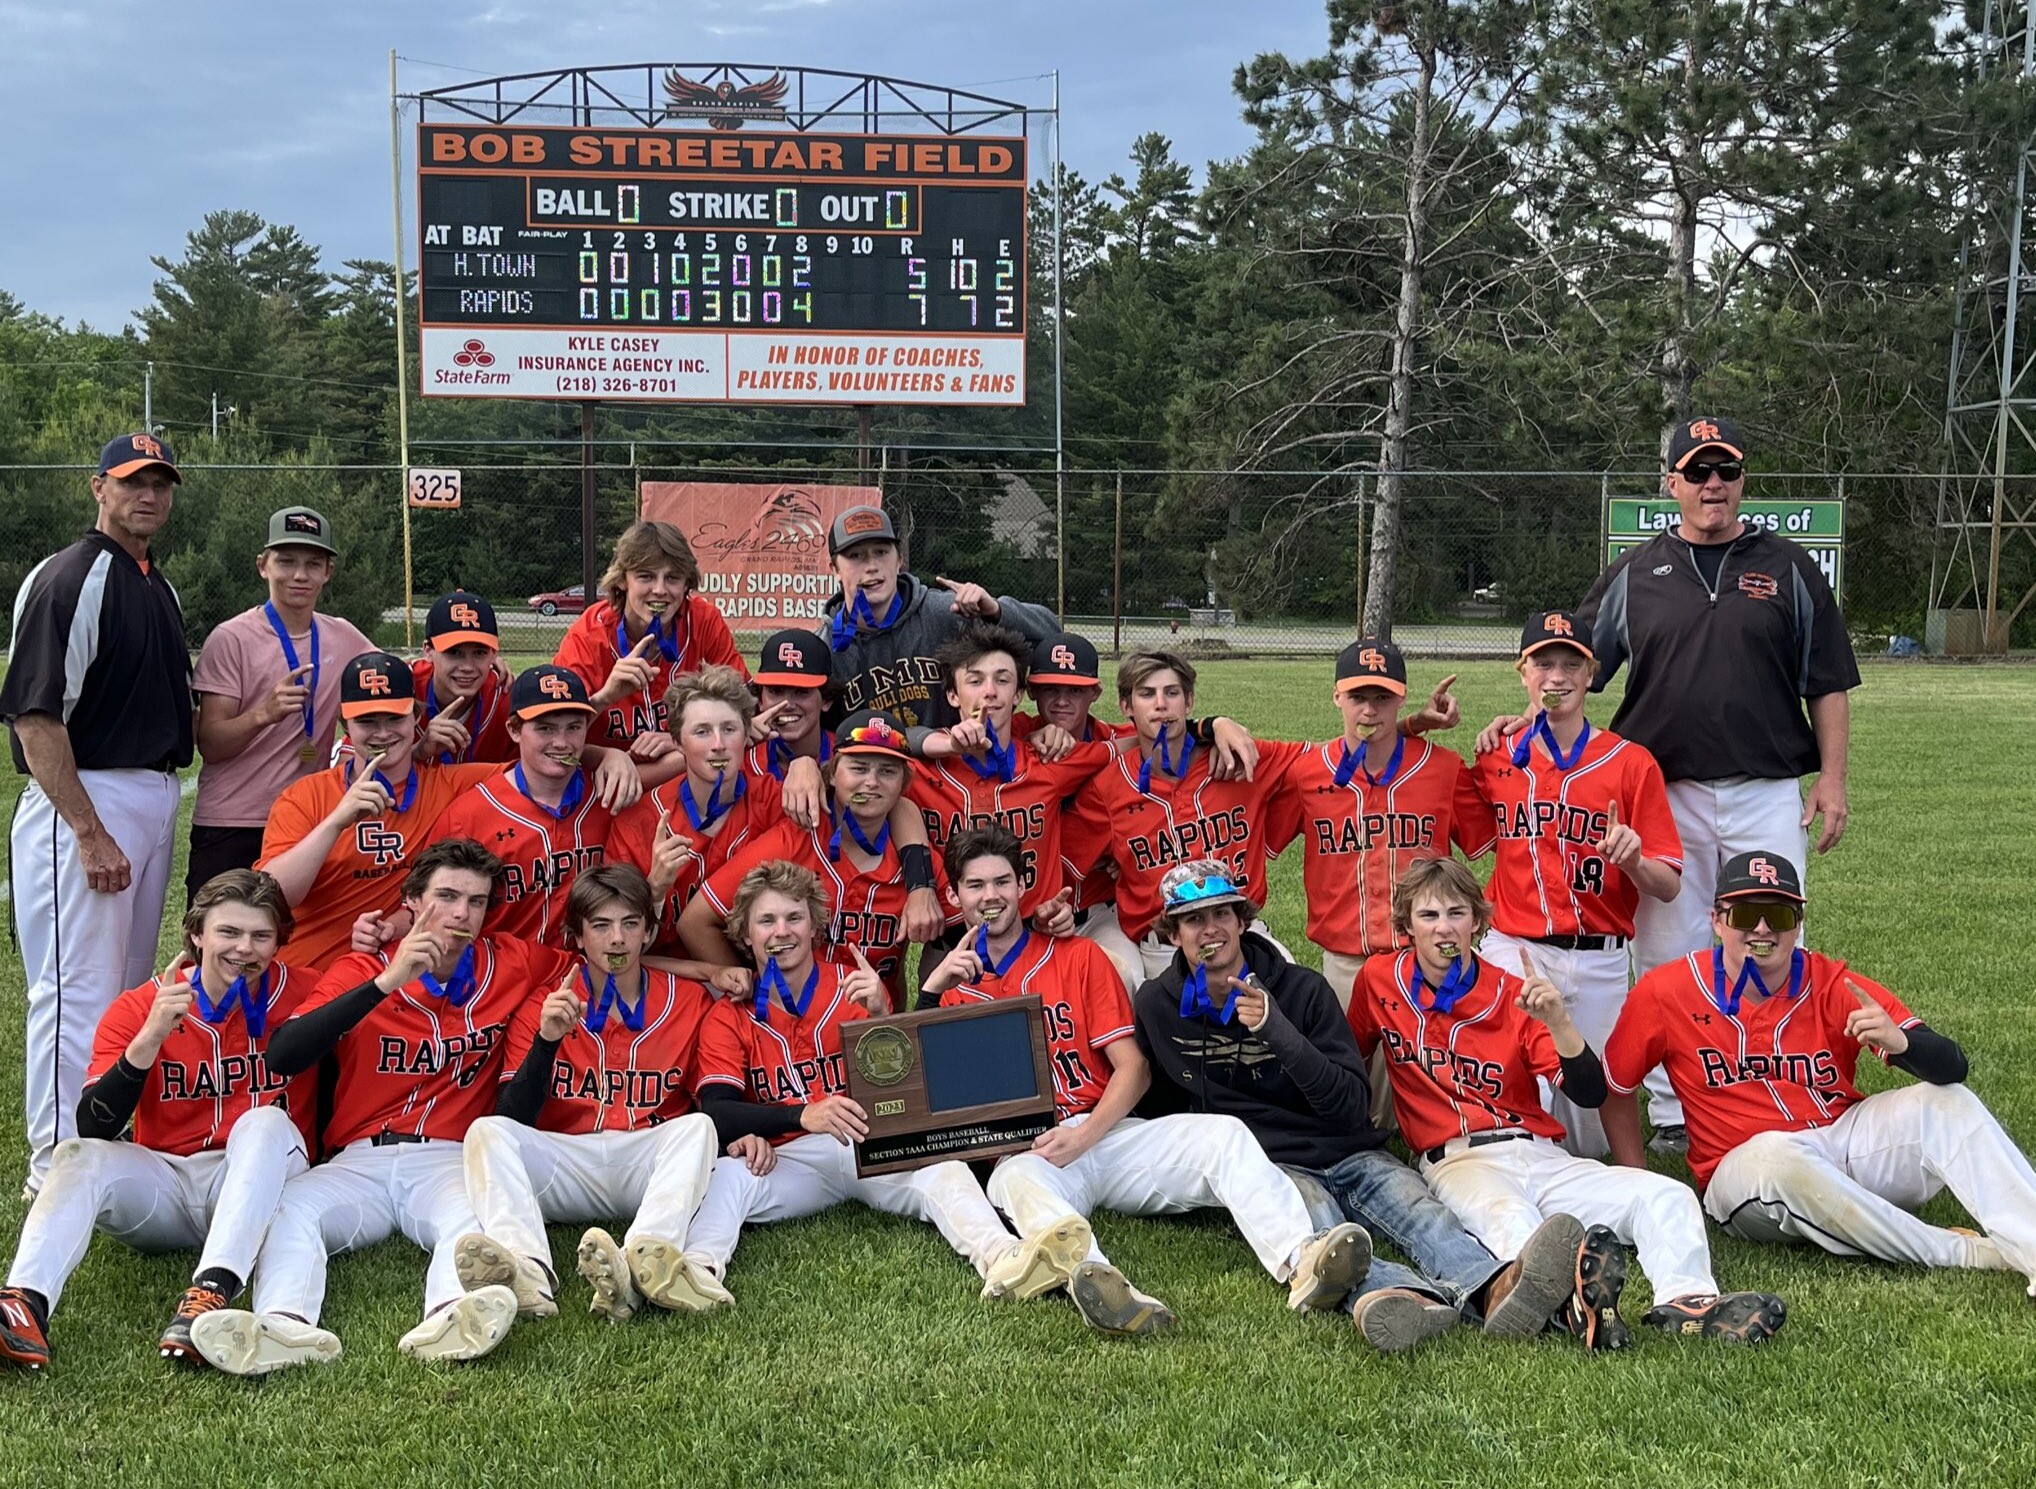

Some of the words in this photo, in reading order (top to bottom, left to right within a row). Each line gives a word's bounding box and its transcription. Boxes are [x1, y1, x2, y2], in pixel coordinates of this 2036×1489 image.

[433, 133, 546, 163] BOB
[569, 136, 843, 170] STREETAR
[864, 142, 1014, 174] FIELD
[536, 188, 611, 216] BALL
[618, 184, 640, 223] 0
[668, 191, 770, 220] STRIKE
[775, 188, 797, 227] 0
[820, 195, 879, 221] OUT
[886, 190, 907, 229] 0
[424, 225, 451, 245] AT
[462, 226, 504, 247] BAT
[518, 230, 568, 239] FAIR-PLAY
[582, 231, 593, 248] 1
[613, 232, 626, 249] 2
[643, 232, 656, 250] 3
[673, 233, 686, 250] 4
[705, 234, 717, 251] 5
[735, 234, 747, 251] 6
[765, 235, 777, 252] 7
[795, 236, 808, 252] 8
[826, 236, 838, 253] 9
[851, 237, 873, 254] 10
[900, 237, 913, 255] R
[952, 239, 964, 256] H
[1000, 239, 1009, 257] E
[579, 251, 598, 283] 0
[610, 252, 628, 283] 0
[653, 252, 660, 284] 1
[671, 253, 690, 284] 0
[702, 254, 720, 285] 2
[732, 255, 750, 286] 0
[763, 255, 781, 286] 0
[793, 256, 811, 287] 2
[908, 258, 926, 289] 5
[950, 258, 977, 290] 10
[996, 259, 1013, 290] 2
[460, 289, 534, 314] RAPIDS
[580, 288, 598, 319] 0
[610, 289, 629, 320] 0
[641, 289, 660, 320] 0
[671, 290, 690, 321] 0
[702, 290, 720, 321] 3
[732, 291, 750, 322] 0
[763, 292, 781, 323] 0
[793, 292, 811, 323] 4
[908, 294, 926, 325] 7
[959, 295, 977, 326] 7
[996, 295, 1013, 327] 2
[568, 336, 605, 351] KYLE
[611, 338, 660, 353] CASEY
[768, 345, 789, 364] IN
[793, 346, 860, 365] HONOR
[865, 347, 888, 366] OF
[891, 348, 985, 369] COACHES,
[518, 357, 607, 372] INSURANCE
[612, 358, 675, 373] AGENCY
[678, 359, 710, 374] INC.
[556, 377, 597, 393] (218)
[603, 379, 677, 393] 326-8701
[737, 371, 822, 391] PLAYERS,
[828, 372, 946, 392] VOLUNTEERS
[950, 374, 963, 392] &
[969, 374, 1016, 393] FANS
[414, 475, 457, 502] 325
[1786, 508, 1812, 532] of
[690, 522, 760, 562] Eagles
[761, 530, 826, 553] 2469
[715, 597, 777, 618] RAPIDS
[844, 656, 943, 711] UMD
[1314, 813, 1436, 855] RAPIDS
[1494, 802, 1609, 846] RAPIDS
[1126, 804, 1251, 872] RAPIDS
[1571, 853, 1605, 896] 18
[878, 1101, 902, 1113] 2023
[869, 1149, 905, 1161] SECTION
[905, 1145, 926, 1155] 7AAA
[926, 1138, 970, 1152] CHAMPION
[970, 1136, 978, 1145] &
[977, 1132, 1004, 1144] STATE
[1004, 1126, 1048, 1141] QUALIFIER
[926, 1132, 947, 1142] BOYS
[949, 1126, 990, 1140] BASEBALL
